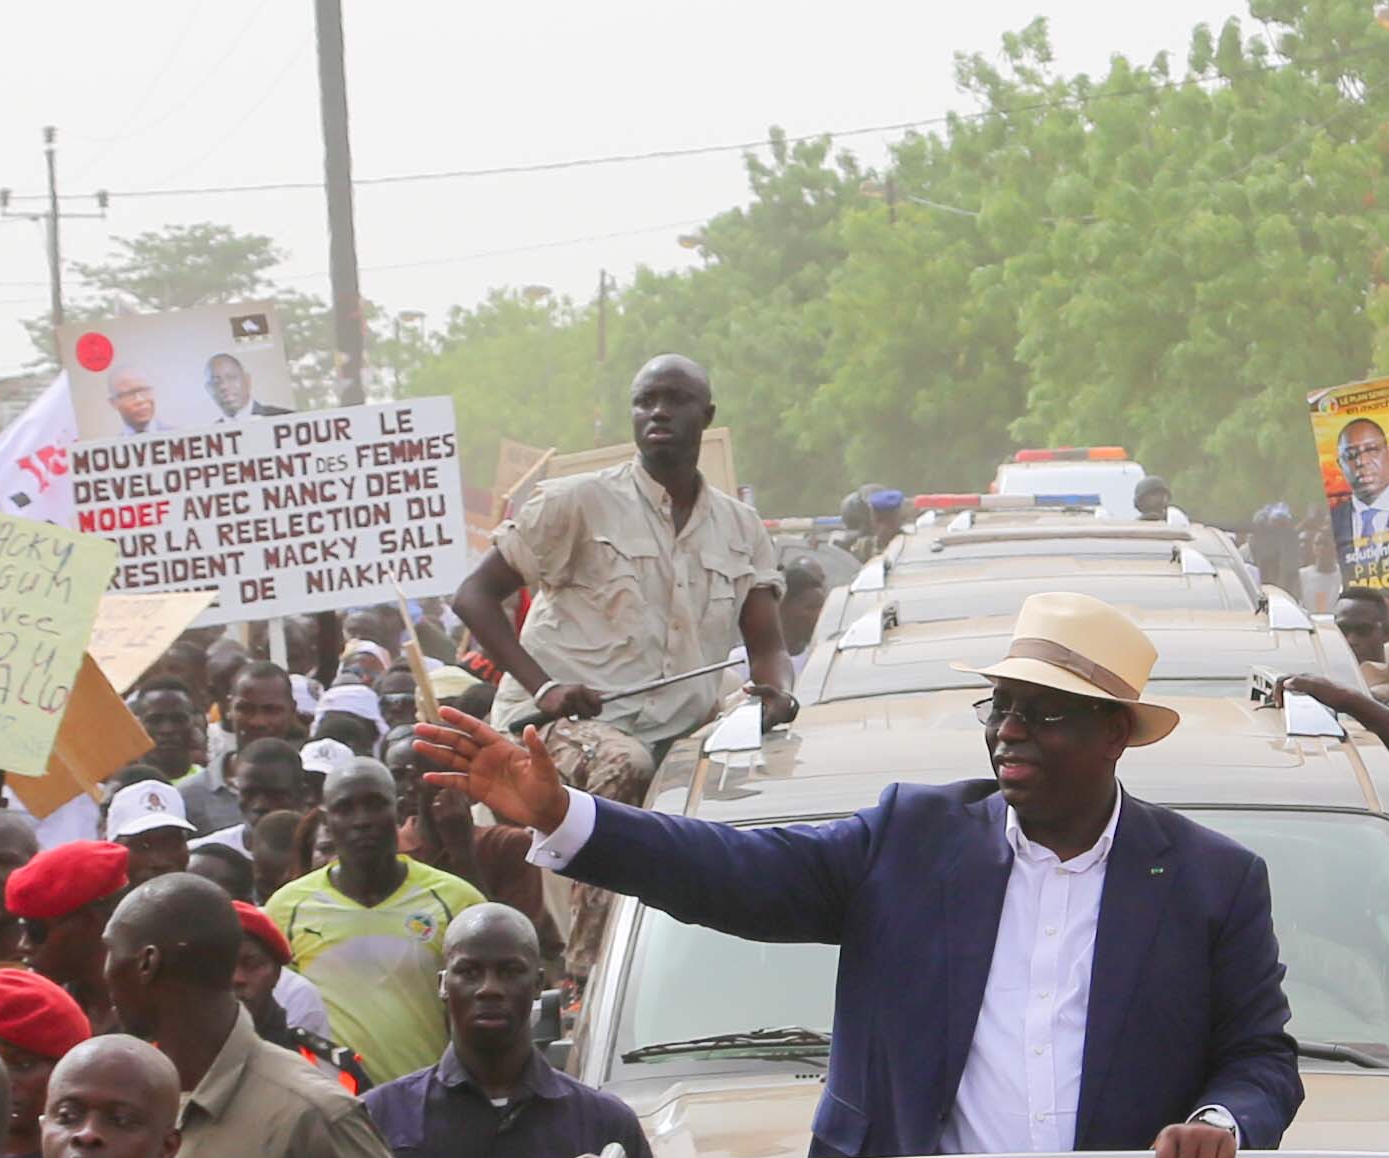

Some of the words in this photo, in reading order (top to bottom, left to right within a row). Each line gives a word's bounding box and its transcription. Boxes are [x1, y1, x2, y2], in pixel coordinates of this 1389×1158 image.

[72, 431, 242, 475] MOUVEMENT
[273, 417, 352, 449] POUR
[380, 409, 414, 435] LE
[73, 452, 312, 505] DEVELOPPEMENT
[316, 454, 349, 474] DES
[356, 433, 456, 468] FEMMES
[78, 500, 170, 533] MODEF
[184, 490, 251, 522] AVEC
[262, 476, 356, 511] NANCY
[366, 466, 439, 498] DEME
[165, 527, 202, 553] LA
[217, 501, 391, 547] REELECTION
[407, 494, 447, 521] DU
[107, 551, 244, 591] RESIDENT
[265, 535, 357, 571] MACKY
[379, 524, 454, 554] SALL
[239, 576, 277, 604] DE
[306, 555, 434, 594] NIAKHAR
